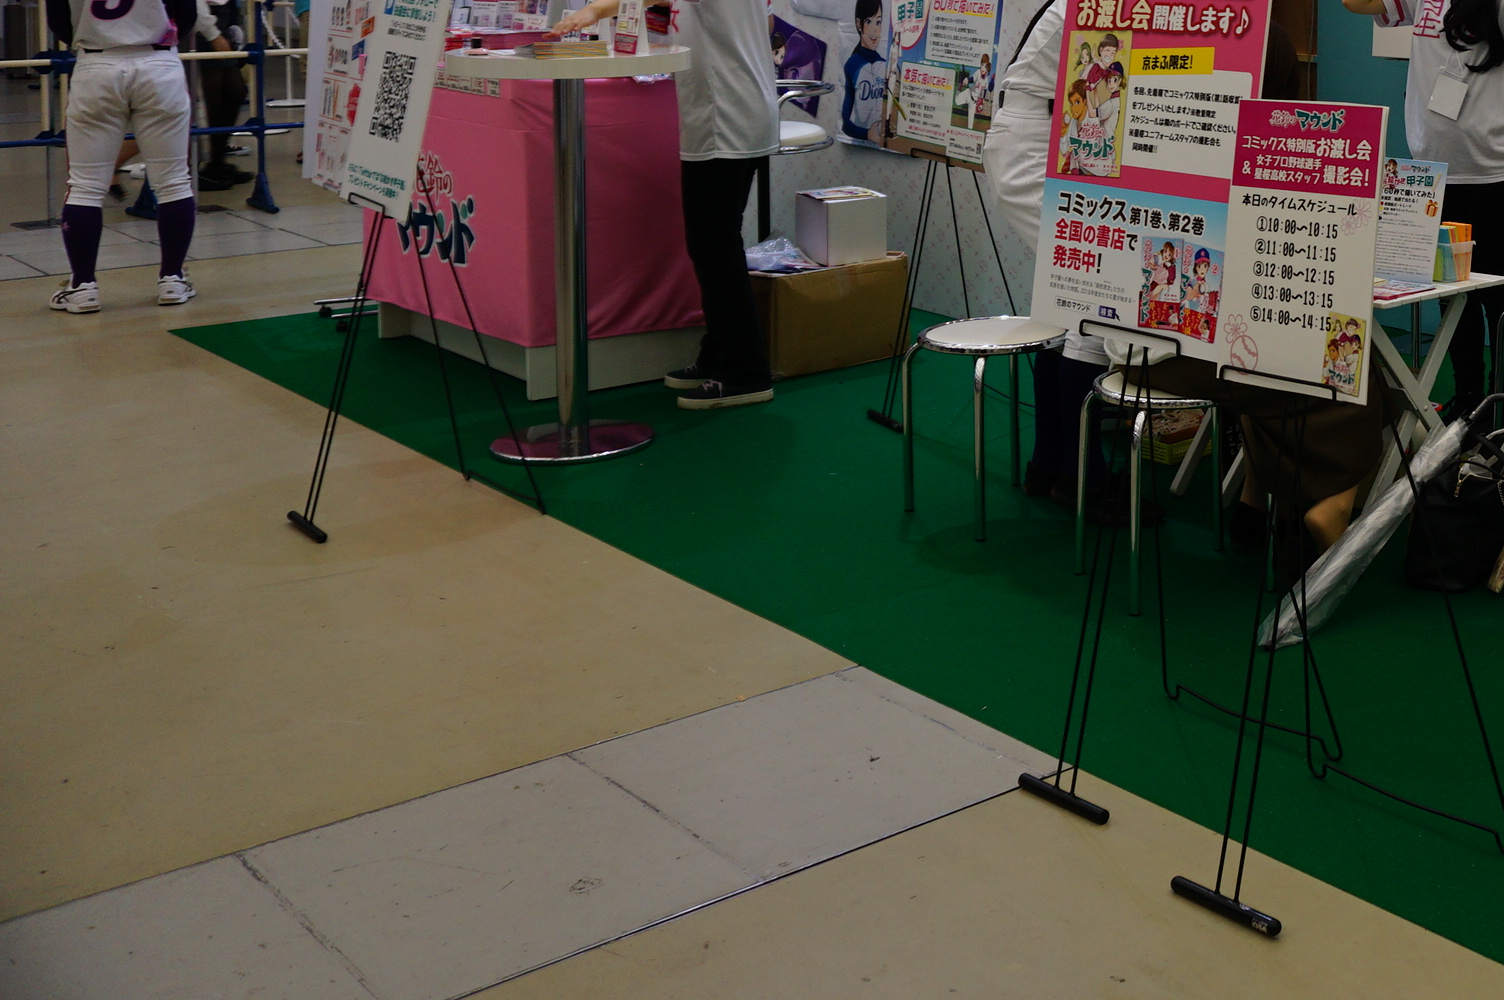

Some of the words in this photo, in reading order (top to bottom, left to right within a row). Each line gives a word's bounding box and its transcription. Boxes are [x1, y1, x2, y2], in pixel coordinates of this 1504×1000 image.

[1142, 55, 1194, 70] 京まふ限定!
[859, 80, 885, 101] Dion
[1242, 161, 1251, 174] &
[1323, 165, 1369, 187] 撮影会!
[1256, 154, 1322, 170] 女子プロ野球選手
[1058, 192, 1126, 222] コミックス
[1129, 207, 1205, 236] 第1巻、第2巻
[1242, 193, 1358, 216] 本日のタイムスケジュール
[1055, 218, 1138, 251] 全国の書店で
[1053, 245, 1102, 274] 発売中!
